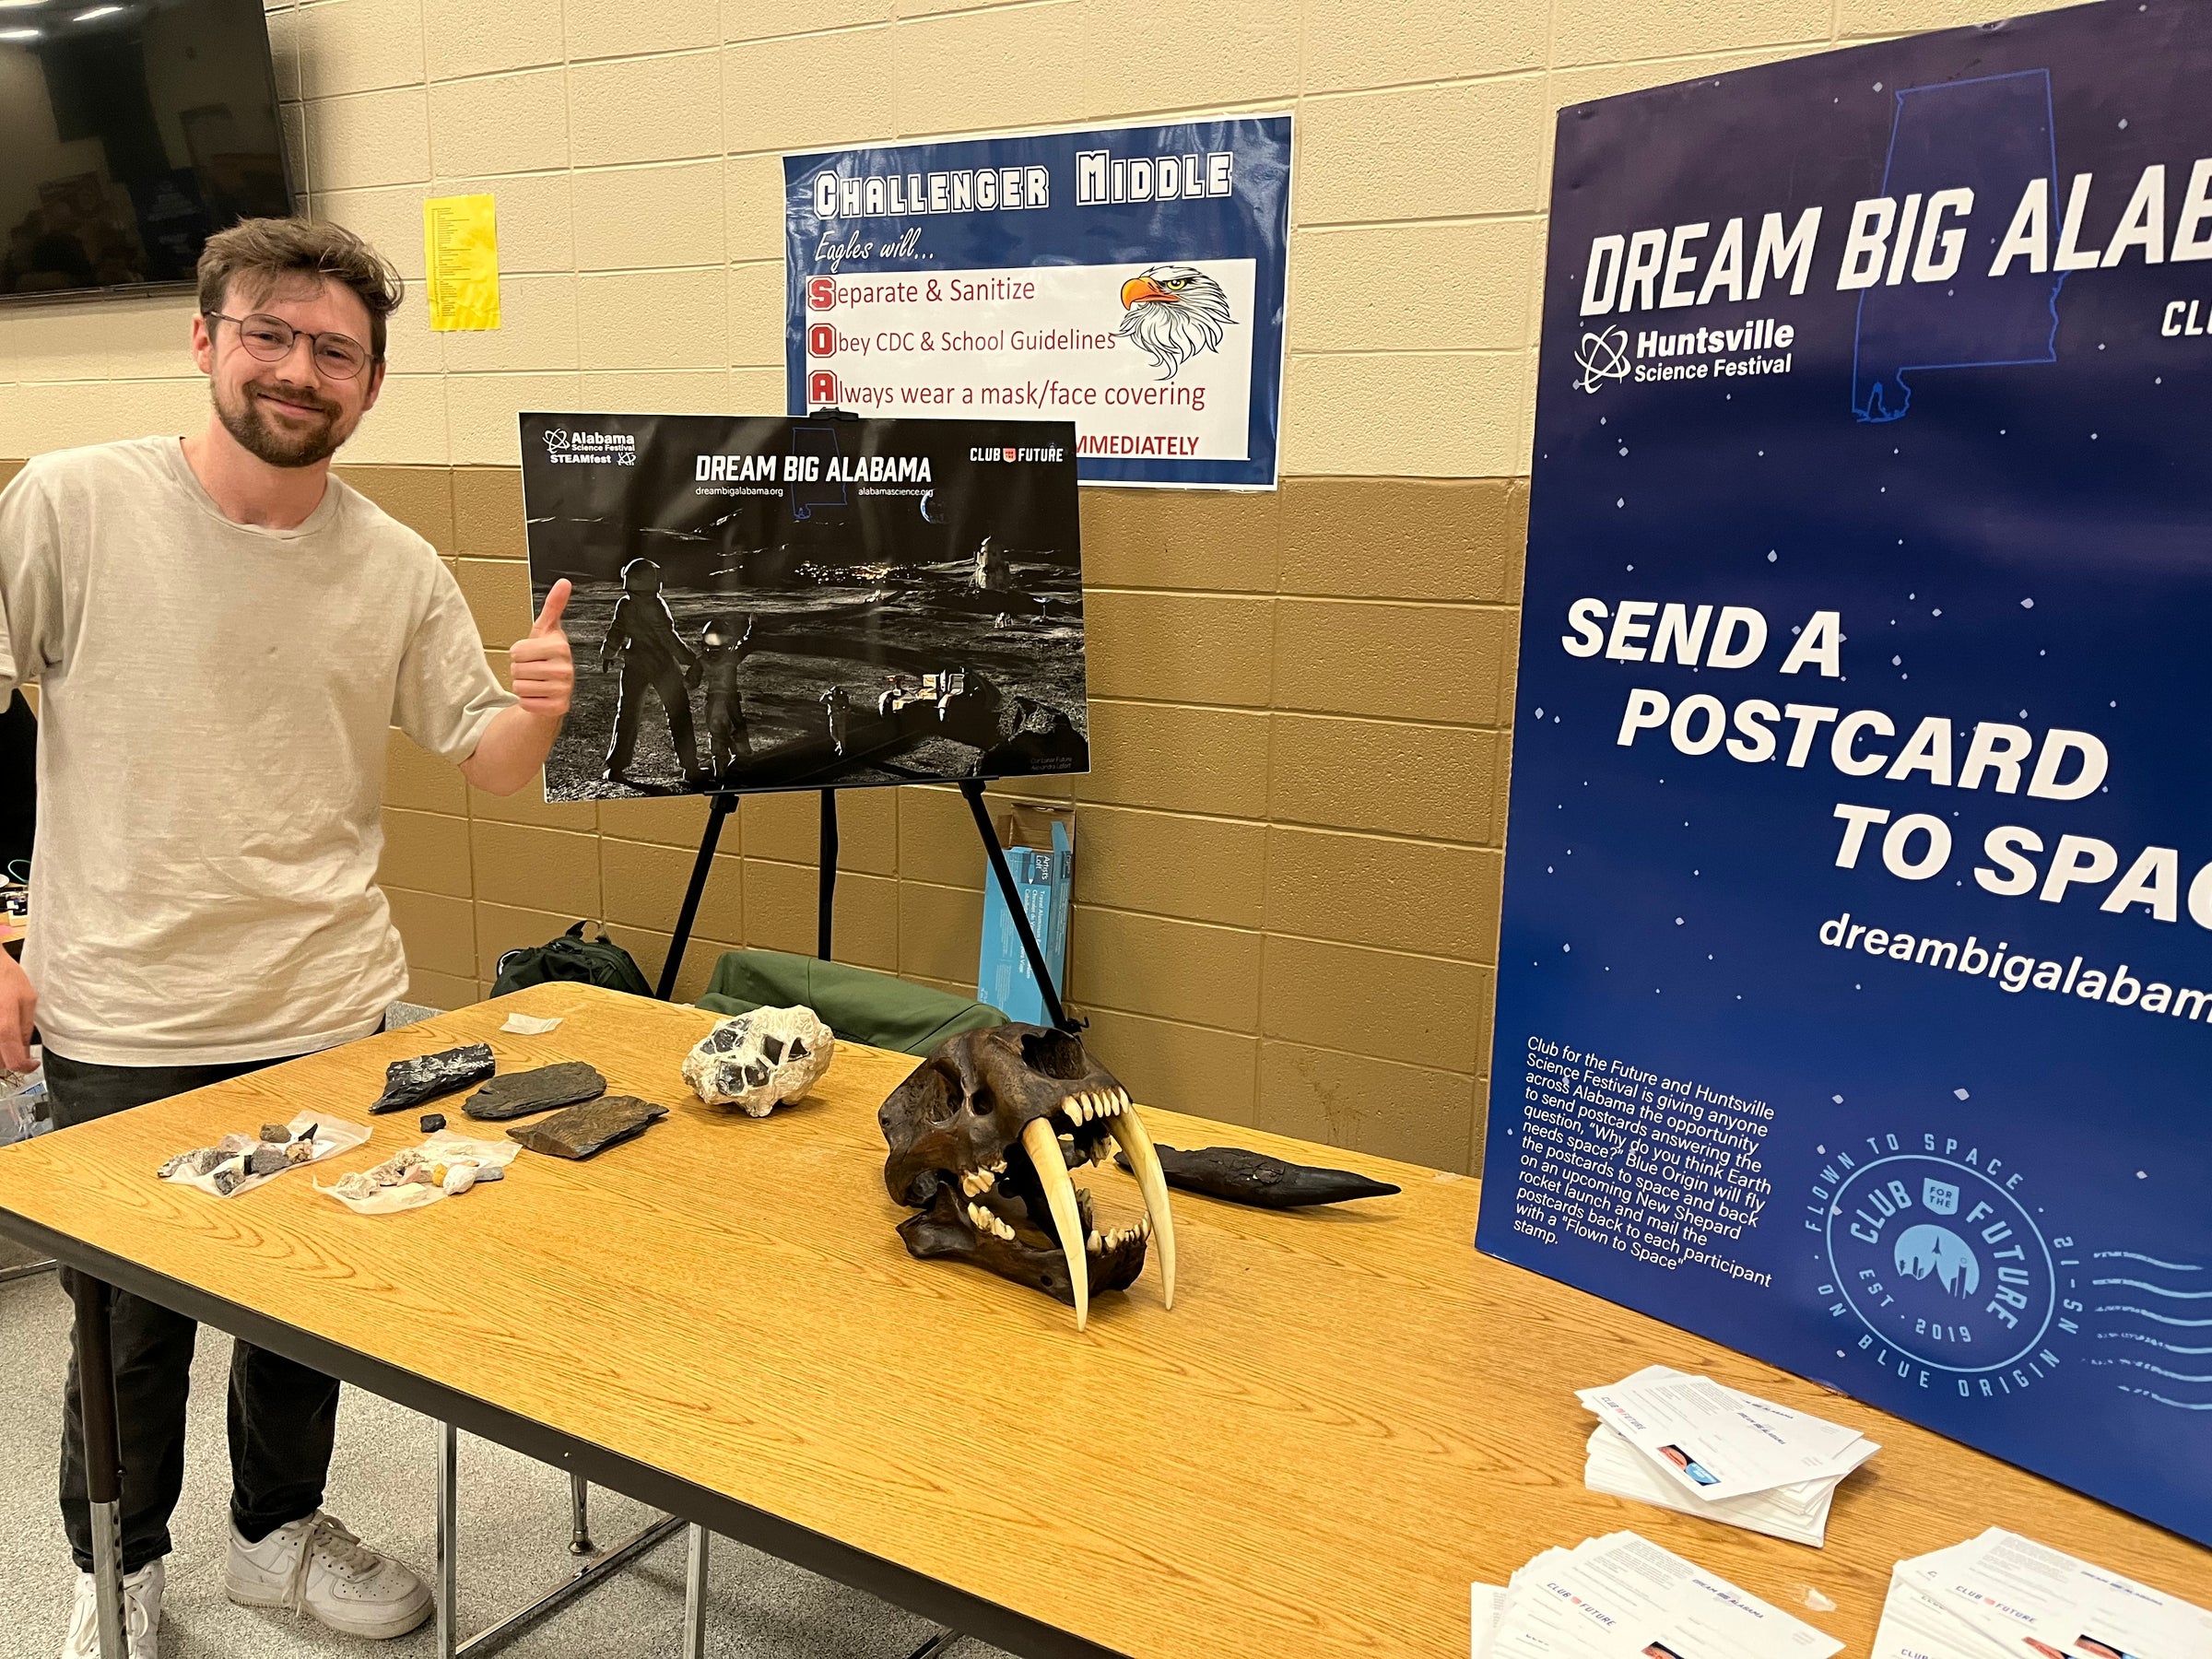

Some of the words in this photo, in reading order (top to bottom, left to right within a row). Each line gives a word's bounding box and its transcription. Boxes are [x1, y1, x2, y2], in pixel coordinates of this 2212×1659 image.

[814, 165, 1049, 220] CHALLENGER
[1076, 149, 1233, 206] MIDDLE
[815, 229, 874, 274] Eagles
[879, 227, 935, 260] will...
[1579, 206, 1823, 317] DREAM
[1836, 187, 1975, 291] BIG
[1989, 158, 2212, 276] ALAB
[807, 276, 918, 312] Separate
[925, 279, 943, 301] &
[950, 277, 1035, 301] Sanitize
[2161, 300, 2212, 336] CL
[807, 323, 871, 359] Obey
[876, 332, 914, 351] CDC
[920, 331, 935, 351] &
[941, 330, 1004, 351] School
[1010, 328, 1116, 351] Guidelines
[1634, 359, 1708, 382] Science
[1713, 353, 1793, 378] Festival
[1636, 318, 1795, 359] Huntsville
[807, 370, 893, 408] Always
[900, 387, 954, 404] wear
[961, 387, 972, 404] a
[982, 380, 1096, 409] mask/face
[1104, 382, 1206, 411] covering
[550, 453, 612, 464] STEAMfest
[571, 431, 635, 444] Alabama
[695, 454, 777, 482] DREAM
[783, 456, 819, 482] BIG
[826, 456, 932, 482] ALABAMA
[970, 447, 1001, 462] CLUB
[1018, 448, 1064, 462] FUTURE
[1076, 435, 1199, 455] MMEDIATELY
[695, 487, 783, 498] dreambigalabama.org
[858, 488, 934, 498] alabamascience.org
[1561, 597, 1769, 669] SEND
[1780, 610, 1841, 677] A
[1617, 688, 2110, 801] POSTCARD
[1831, 804, 1952, 880] TO
[1526, 1053, 1580, 1080] Science
[1583, 1069, 1639, 1098] Festival
[1641, 1087, 1653, 1103] is
[1656, 1094, 1704, 1122] giving
[1708, 1111, 1769, 1137] anyone
[1527, 1036, 1559, 1057] Club
[1562, 1045, 1582, 1063] for
[1585, 1053, 1607, 1071] the
[1611, 1060, 1658, 1086] Future
[1661, 1078, 1692, 1096] and
[1695, 1084, 1775, 1120] Huntsville
[1525, 1072, 1570, 1094] across
[1572, 1084, 1635, 1115] Alabama
[1639, 1105, 1663, 1124] the
[1666, 1116, 1759, 1156] opportunity
[1525, 1086, 1538, 1101] to
[1541, 1093, 1576, 1113] send
[1577, 1106, 1648, 1137] postcards
[1651, 1129, 1731, 1167] answering
[1735, 1153, 1762, 1173] the
[1522, 1135, 1544, 1153] the
[1546, 1147, 1615, 1178] postcards
[1618, 1168, 1632, 1183] to
[1635, 1177, 1680, 1200] space
[1683, 1194, 1715, 1212] and
[1718, 1201, 1759, 1228] back
[1523, 1122, 1564, 1144] needs
[1626, 1153, 1658, 1175] Blue
[1662, 1166, 1709, 1193] Origin
[1713, 1185, 1741, 1203] will
[1745, 1193, 1766, 1213] fly
[1524, 1105, 1584, 1135] question,
[1630, 1138, 1649, 1154] do
[1652, 1147, 1681, 1165] you
[1685, 1155, 1724, 1179] think
[1727, 1168, 1771, 1195] Earth
[1805, 1152, 1855, 1232] FLOWN
[1866, 1134, 1899, 1154] TO
[1924, 1133, 2023, 1191] SPACE
[1519, 1171, 1561, 1194] rocket
[1564, 1182, 1611, 1211] launch
[1615, 1204, 1644, 1222] and
[1646, 1216, 1679, 1236] mail
[1682, 1226, 1708, 1246] the
[1521, 1154, 1538, 1169] on
[1541, 1161, 1559, 1176] an
[1561, 1169, 1632, 1204] upcoming
[1635, 1191, 1671, 1215] New
[1674, 1206, 1742, 1240] Shepard
[1929, 1185, 1952, 1198] FOR
[1929, 1195, 1951, 1208] THE
[1513, 1219, 1559, 1245] stamp.
[1516, 1203, 1545, 1222] with
[1547, 1215, 1557, 1227] a
[1562, 1215, 1608, 1245] "Flown
[1612, 1236, 1627, 1252] to
[1630, 1241, 1684, 1270] Space"
[1516, 1187, 1584, 1218] postcards
[1587, 1208, 1623, 1233] back
[1626, 1223, 1641, 1239] to
[1644, 1232, 1680, 1254] each
[1684, 1247, 1772, 1288] participant
[1850, 1180, 1912, 1244] CLUB
[1966, 1201, 2029, 1329] FUTURE
[1818, 1284, 1846, 1316] ON
[1857, 1334, 1930, 1388] BLUE
[1958, 1348, 2060, 1397] ORIGIN
[2053, 1236, 2083, 1335] NS-12
[1859, 1268, 1894, 1307] EST
[1915, 1318, 1971, 1342] 2019
[1547, 1583, 1571, 1597] CLUB
[1579, 1603, 1617, 1626] FUTURE
[1956, 1585, 1983, 1599] CLUB
[1994, 1603, 2037, 1623] FUTURE
